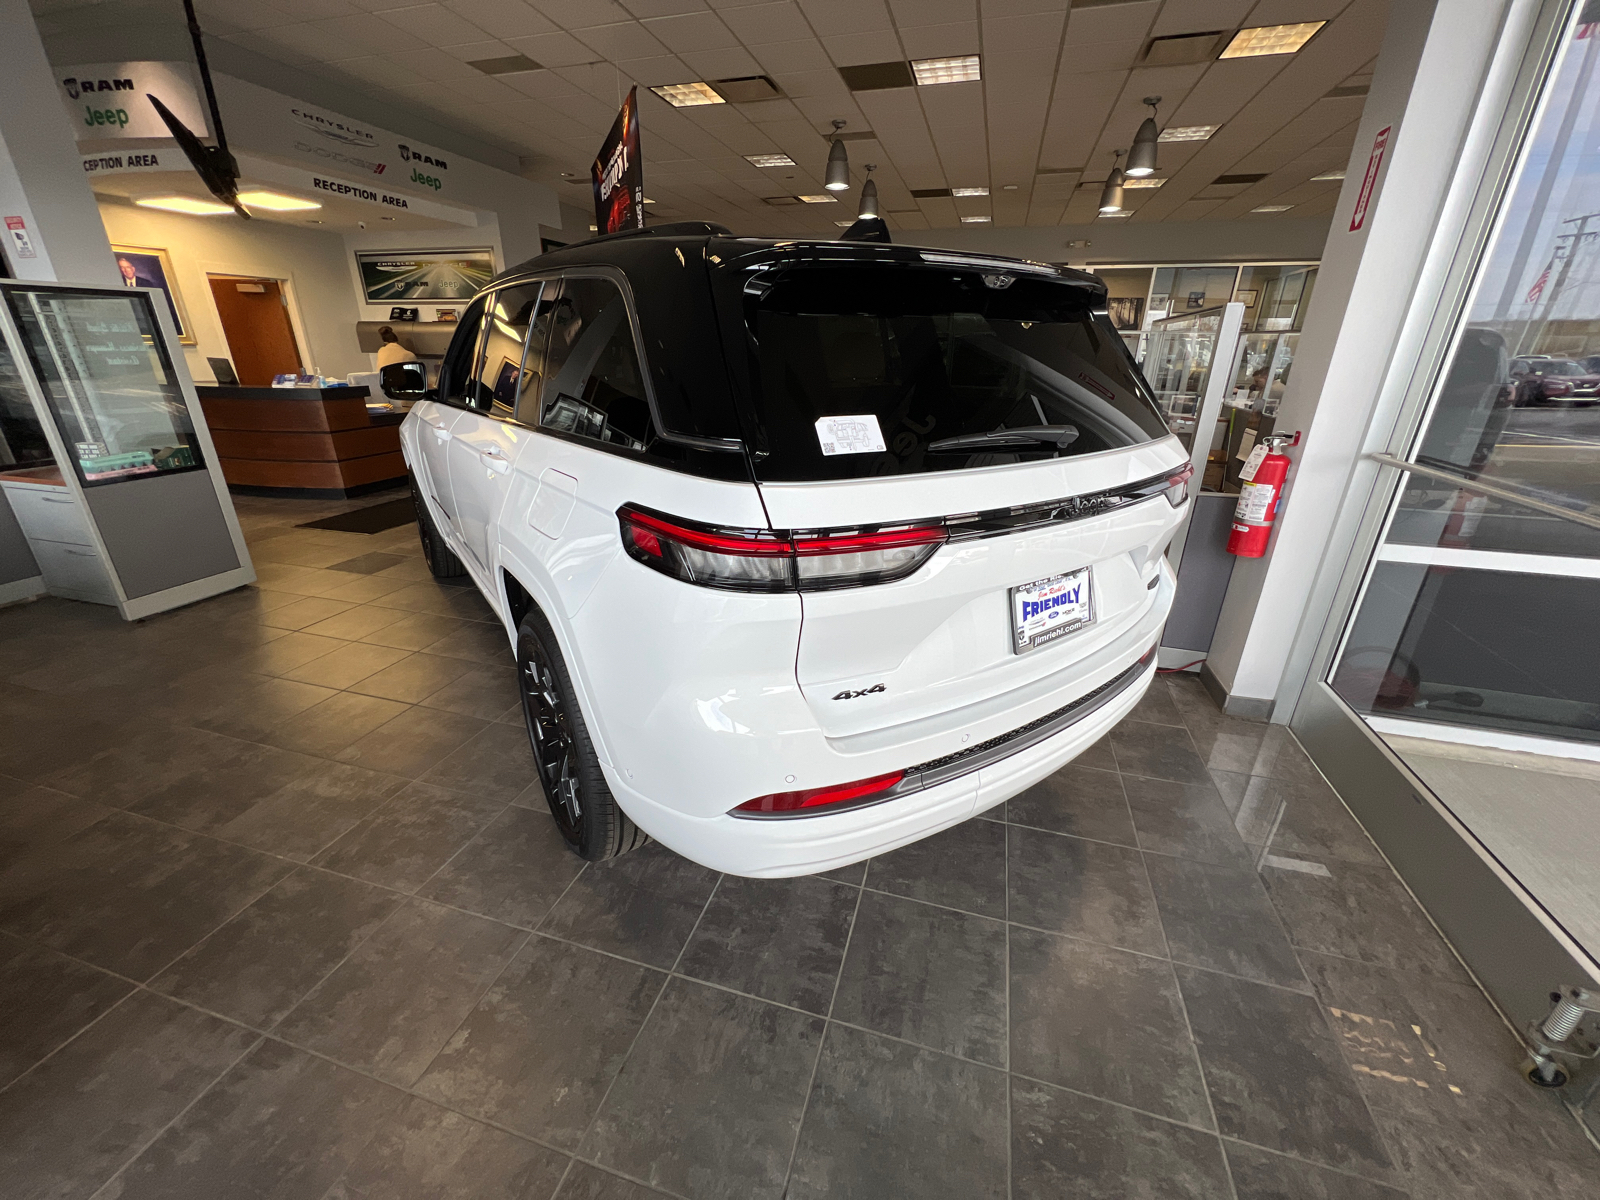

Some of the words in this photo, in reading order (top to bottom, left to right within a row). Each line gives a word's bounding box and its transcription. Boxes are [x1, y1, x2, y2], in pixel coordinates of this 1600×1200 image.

[80, 79, 135, 93] RAM
[84, 105, 129, 129] Jeep
[291, 108, 374, 140] CHRYSLER
[83, 156, 123, 172] CEPTION
[127, 154, 159, 168] AREA
[411, 150, 448, 170] RAM
[410, 167, 442, 191] Jeep
[313, 177, 378, 202] RECEPTION
[381, 194, 409, 209] AREA
[438, 280, 460, 290] Jeep
[1022, 582, 1082, 622] FRIENDLY
[1034, 621, 1082, 647] jimriehl.com
[831, 683, 887, 701] 4x4
